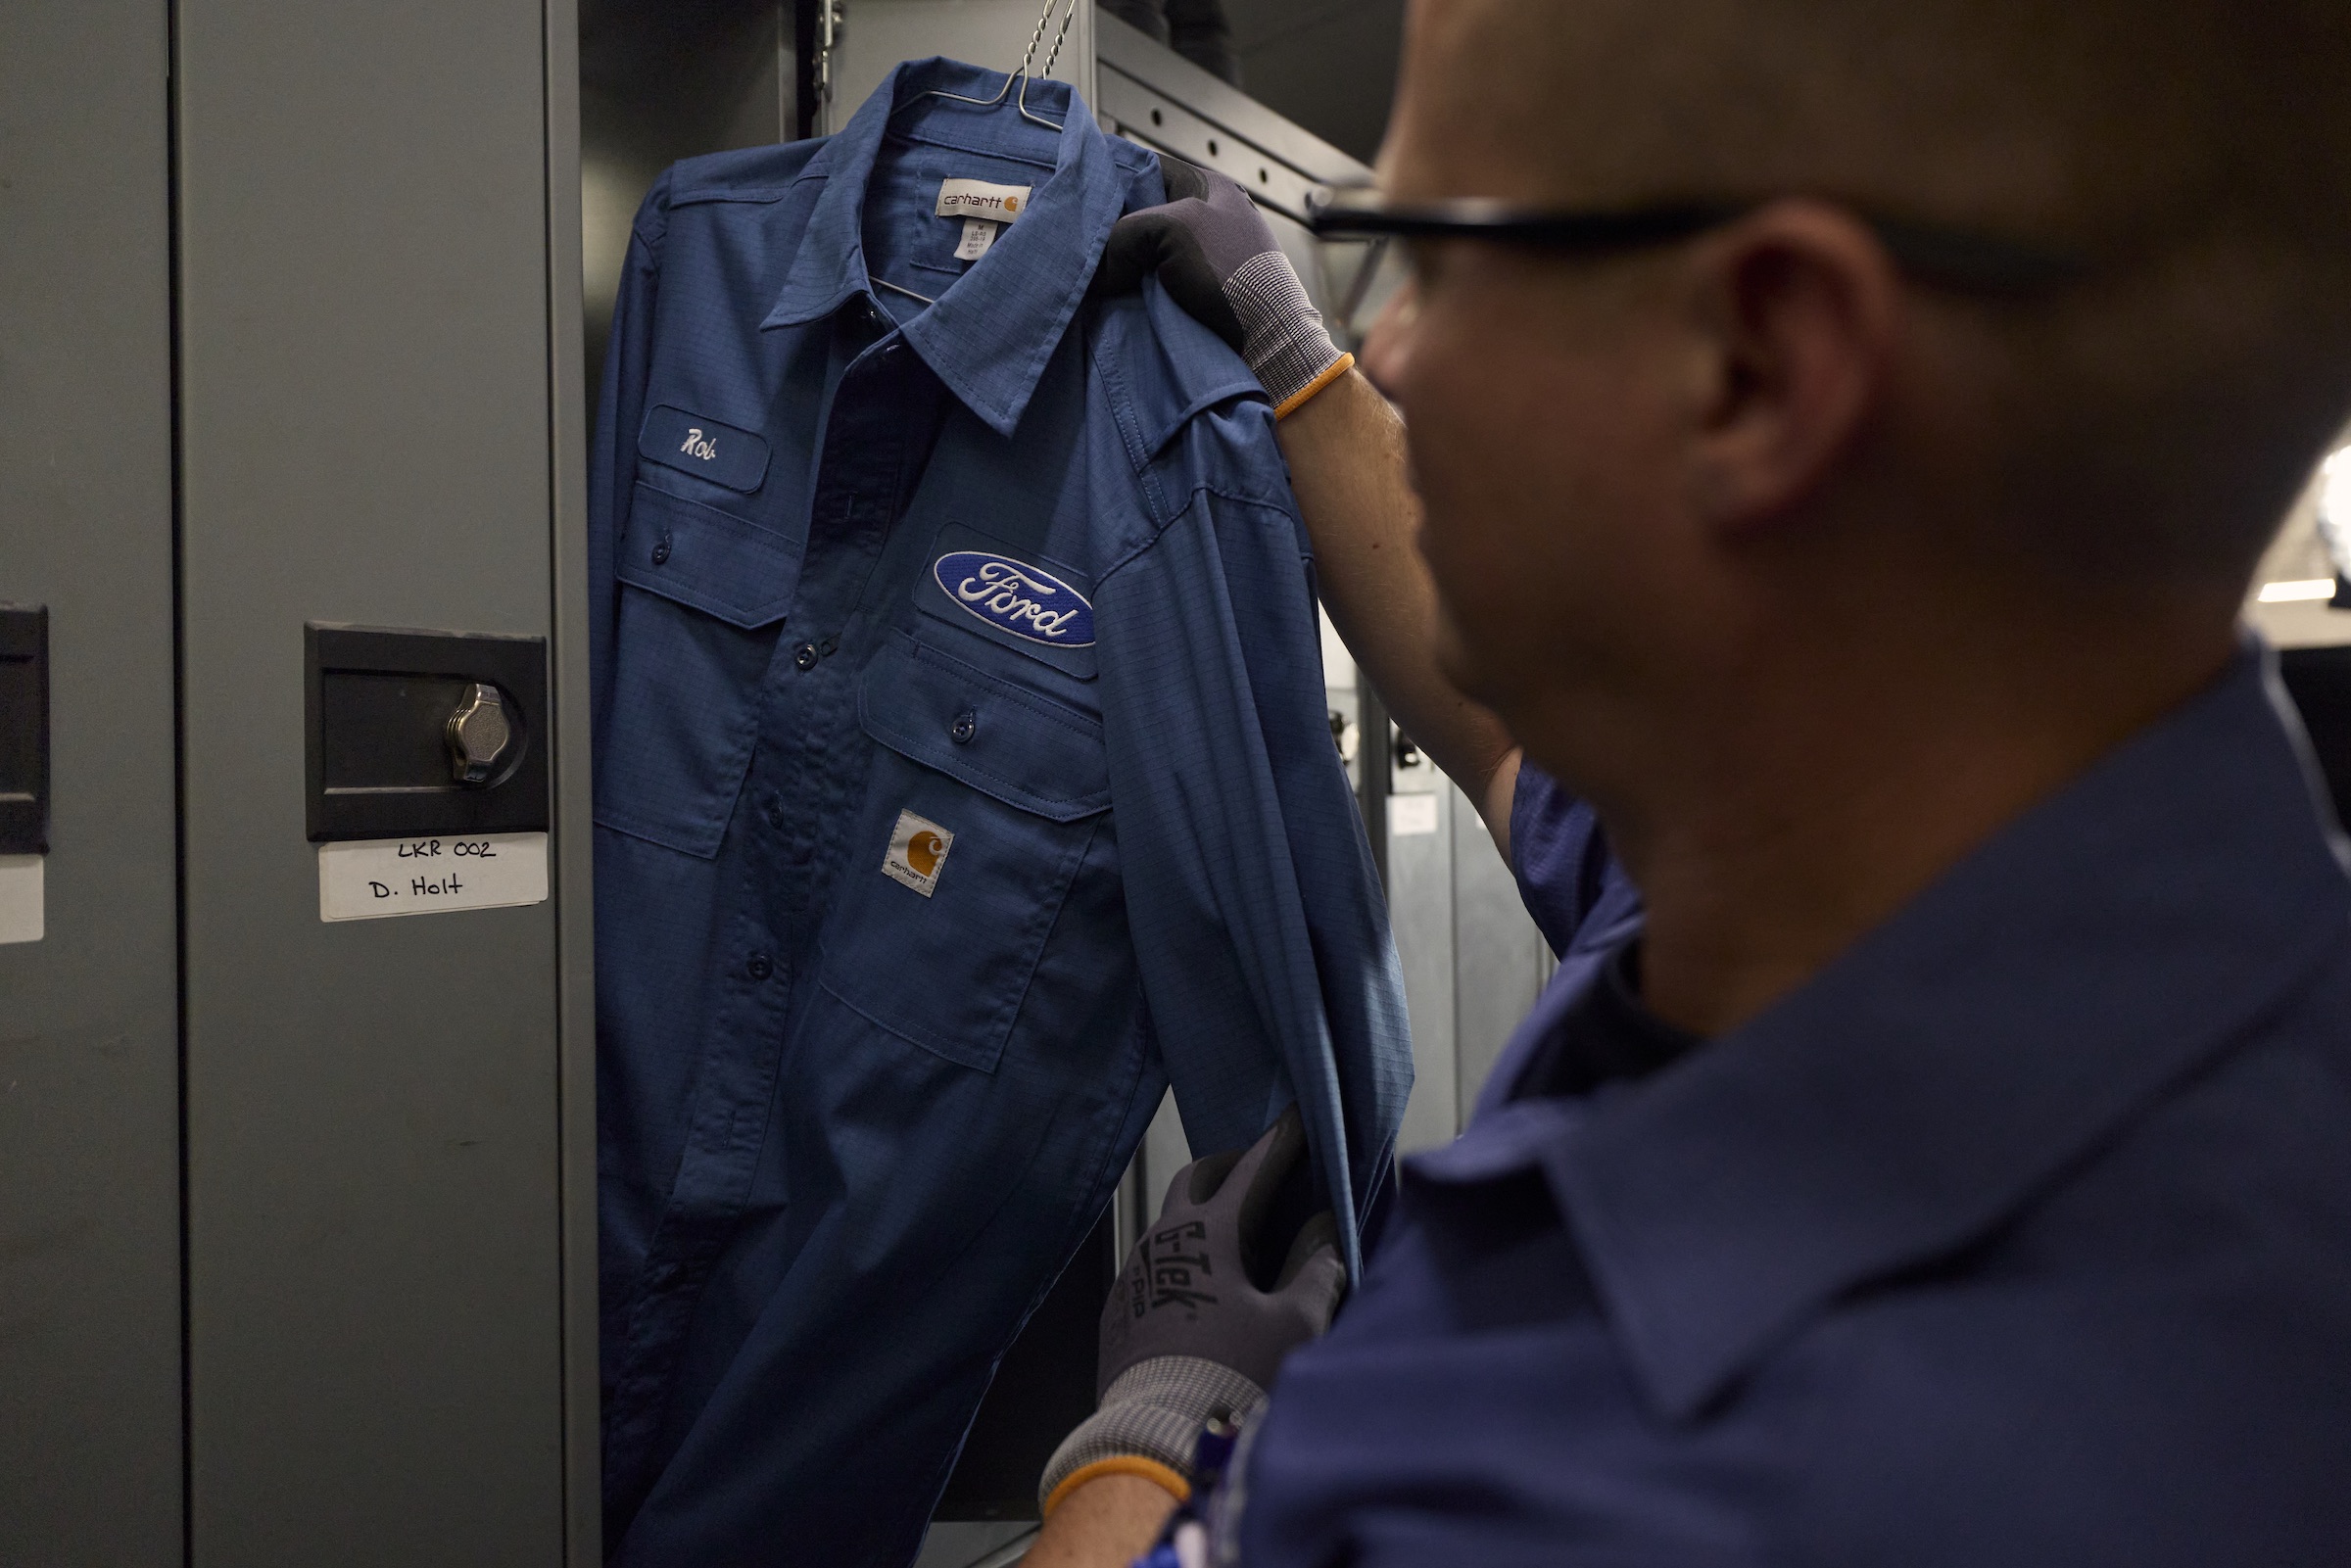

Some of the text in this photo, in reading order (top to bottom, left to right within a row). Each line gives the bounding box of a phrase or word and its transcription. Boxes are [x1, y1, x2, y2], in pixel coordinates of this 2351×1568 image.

[943, 193, 1002, 209] carhartt
[680, 428, 716, 460] Rob
[958, 562, 1079, 637] Ford
[398, 839, 497, 858] LKR 002
[890, 861, 927, 884] carhartt
[368, 873, 463, 898] D. Holt
